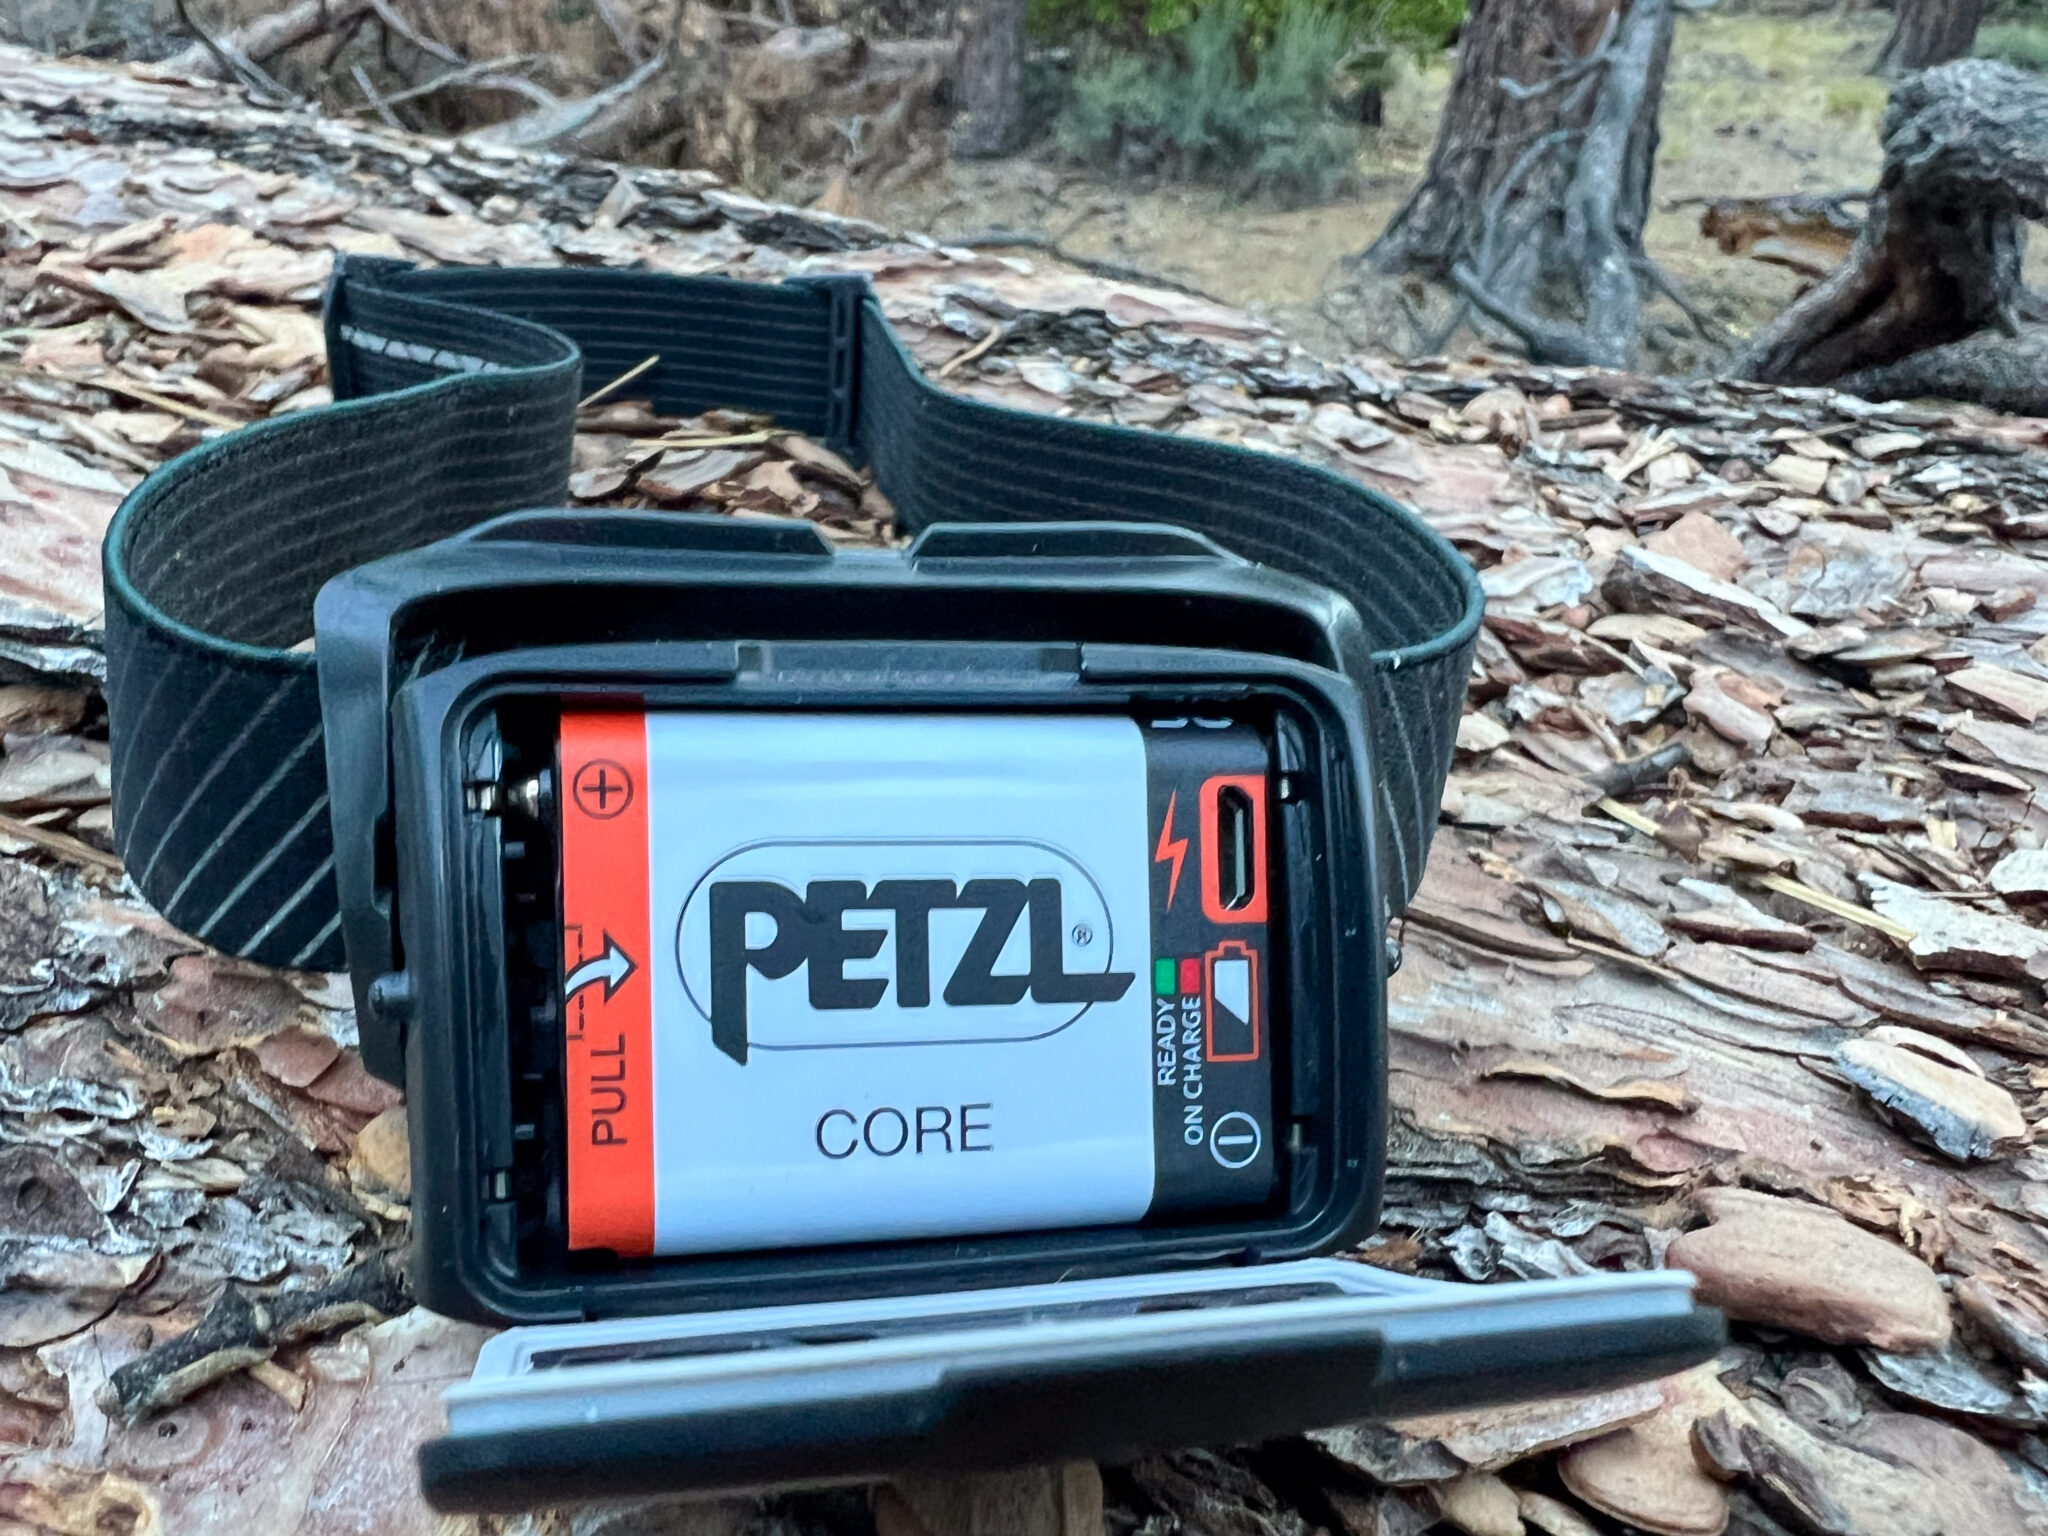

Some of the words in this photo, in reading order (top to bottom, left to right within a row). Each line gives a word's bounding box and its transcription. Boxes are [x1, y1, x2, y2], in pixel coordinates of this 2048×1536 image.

[709, 877, 1136, 1067] PETZL
[591, 1033, 628, 1146] PULL
[1156, 998, 1177, 1086] READY
[1181, 993, 1203, 1101] CHARGE
[814, 1102, 994, 1160] CORE
[1184, 1104, 1204, 1146] ON
